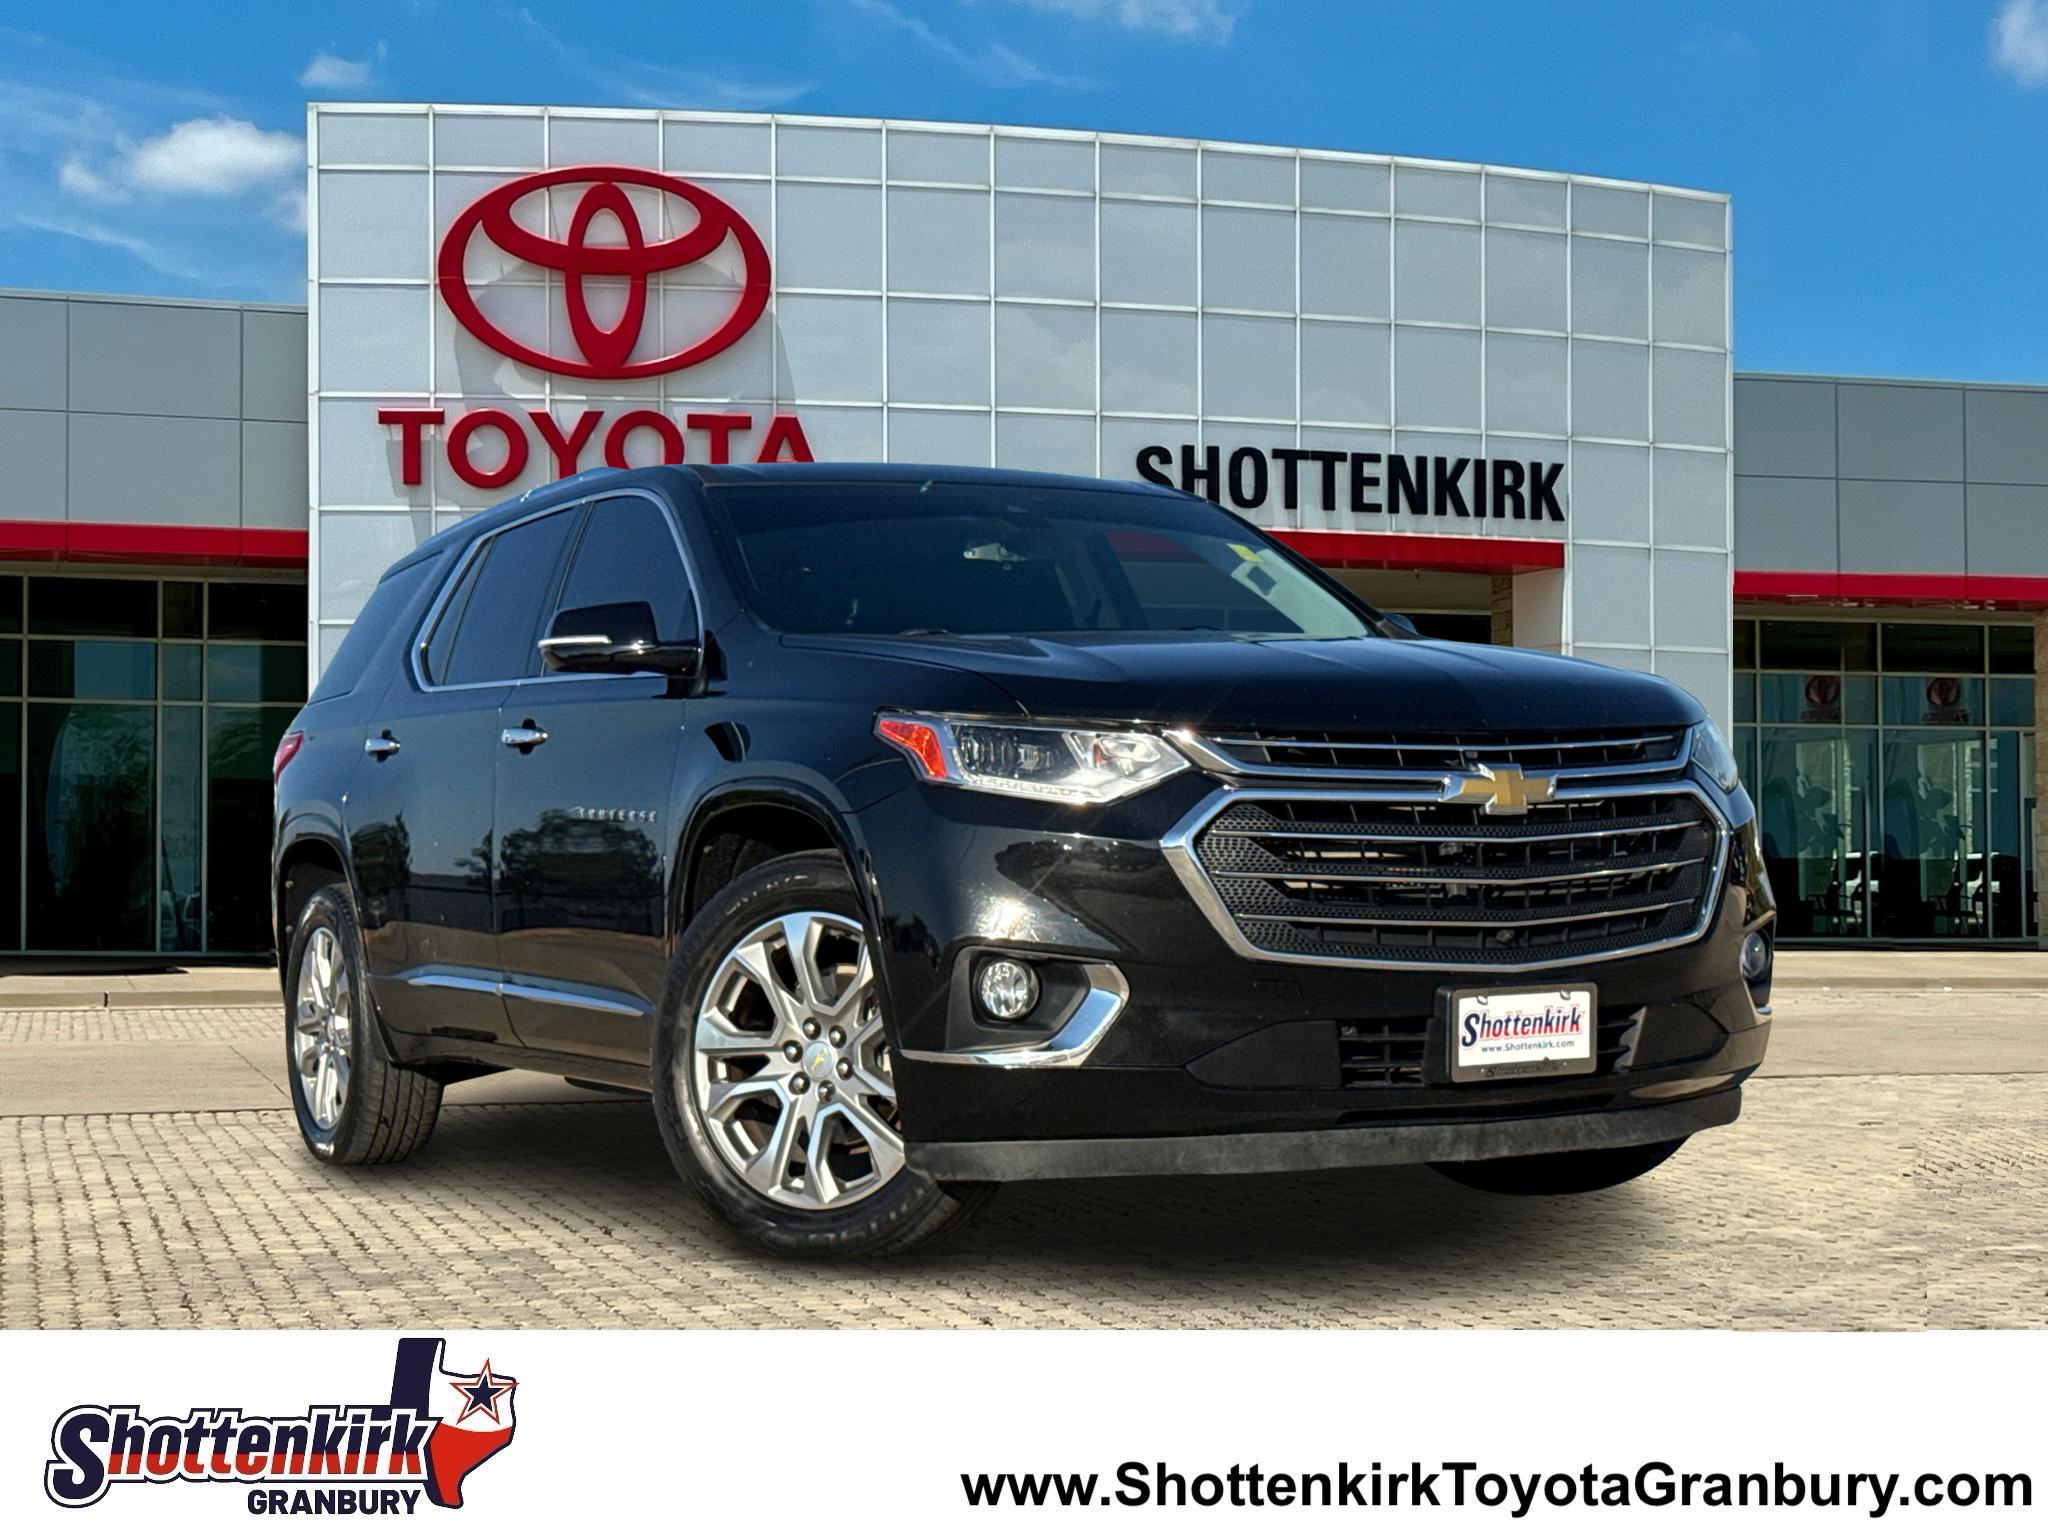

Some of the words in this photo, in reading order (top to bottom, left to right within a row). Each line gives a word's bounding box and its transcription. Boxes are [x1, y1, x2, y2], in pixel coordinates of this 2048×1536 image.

[377, 407, 816, 488] TOYOTA
[1136, 445, 1565, 521] SHOTTENKIRK
[1461, 1006, 1582, 1048] Shottenkirk
[1481, 1040, 1575, 1054] www.Shottenkirk.com
